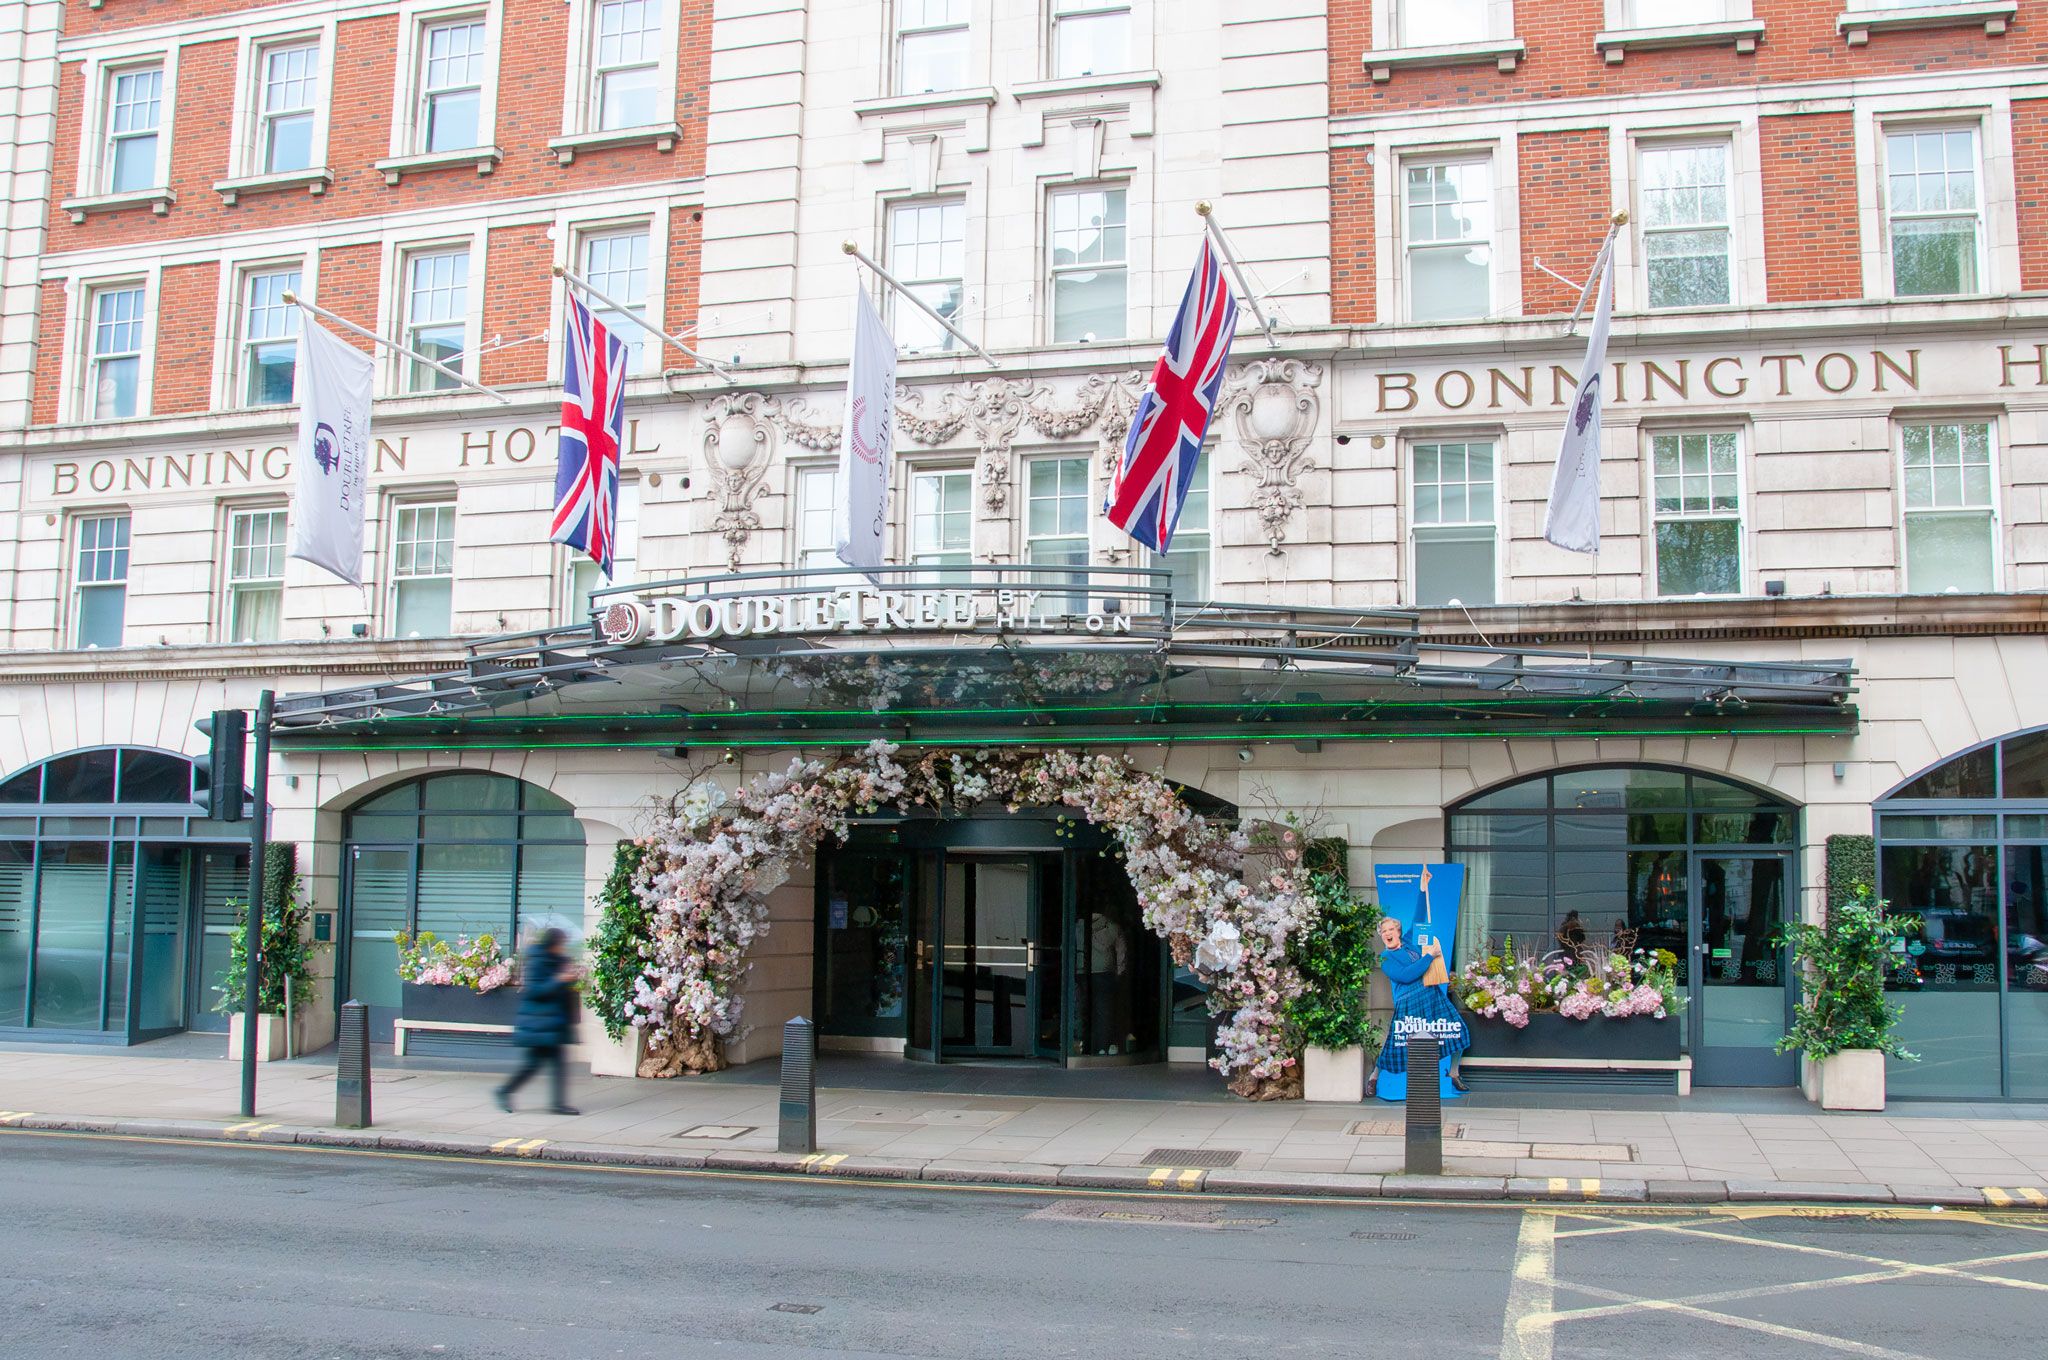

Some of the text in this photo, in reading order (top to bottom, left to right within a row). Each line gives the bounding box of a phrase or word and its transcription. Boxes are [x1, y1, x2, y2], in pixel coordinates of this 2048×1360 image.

[52, 436, 410, 496] BONNINGN
[458, 419, 661, 467] HOL
[998, 589, 1042, 608] BY
[997, 612, 1131, 634] HILTON
[1394, 1017, 1462, 1034] Doubtfire
